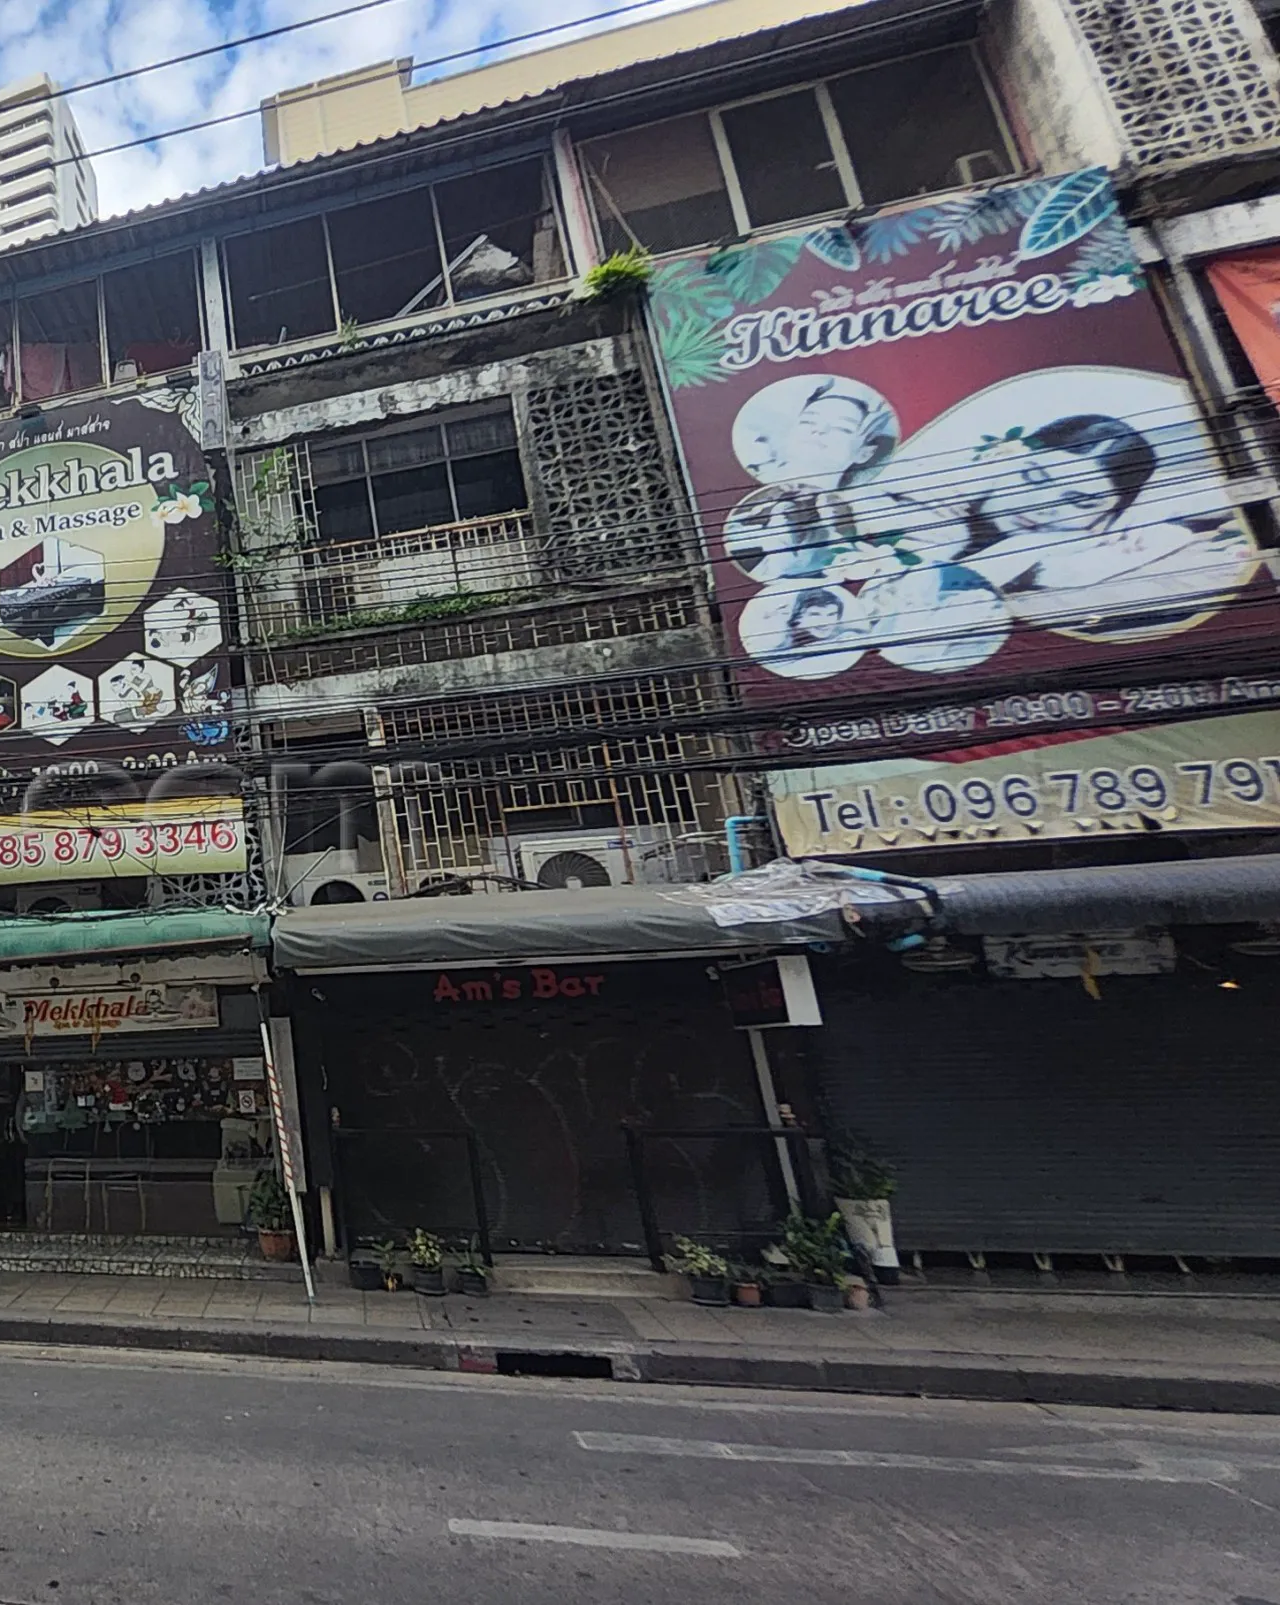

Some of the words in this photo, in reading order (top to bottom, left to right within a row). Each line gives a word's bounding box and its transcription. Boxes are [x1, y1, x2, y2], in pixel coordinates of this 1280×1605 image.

[721, 274, 1067, 370] Kinnaree
[10, 523, 28, 540] &
[35, 501, 142, 528] Massage
[986, 690, 1094, 728] 10:00
[805, 787, 883, 832] Tel
[895, 800, 910, 822] :
[923, 774, 1039, 824] 096
[1048, 766, 1166, 811] 789
[53, 825, 124, 864] 879
[135, 817, 237, 858] 3346
[433, 972, 521, 1002] Am's
[531, 967, 605, 998] Bar
[23, 995, 149, 1024] Mekkhala
